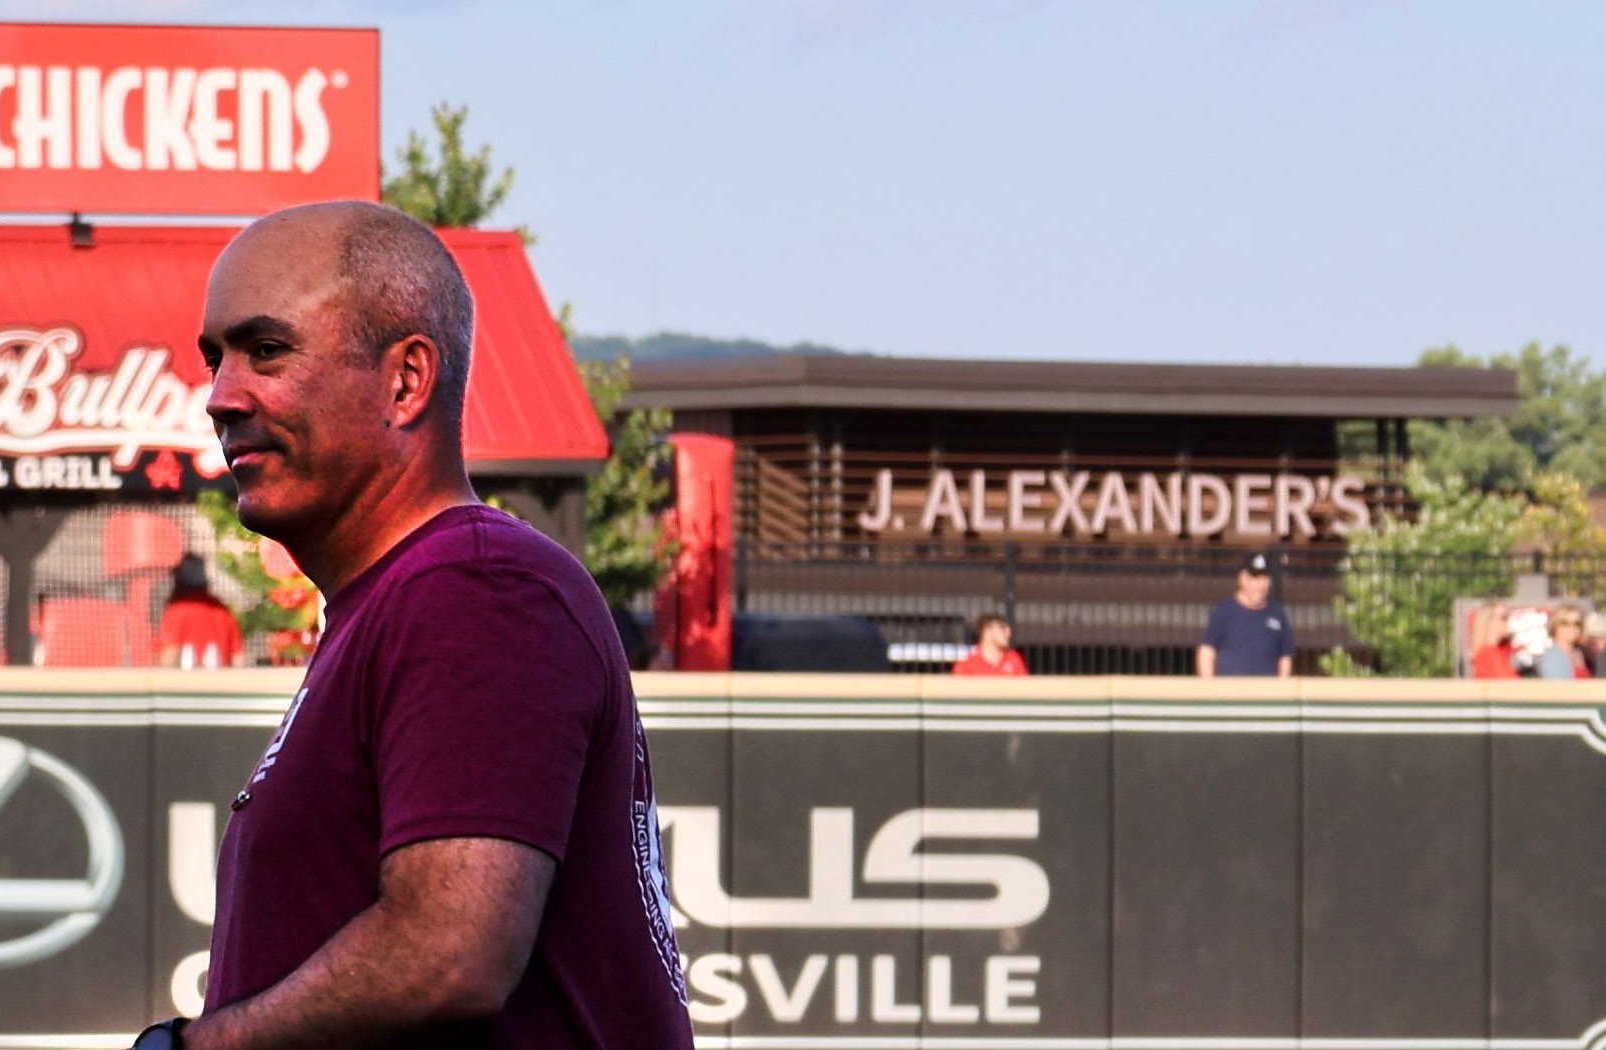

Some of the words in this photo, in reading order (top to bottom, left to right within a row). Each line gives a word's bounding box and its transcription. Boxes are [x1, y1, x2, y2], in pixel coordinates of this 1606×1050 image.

[14, 456, 122, 489] GRILL
[858, 468, 904, 532] J.
[920, 468, 1371, 537] ALEXANDER'S
[681, 952, 1042, 1024] SVILLE
